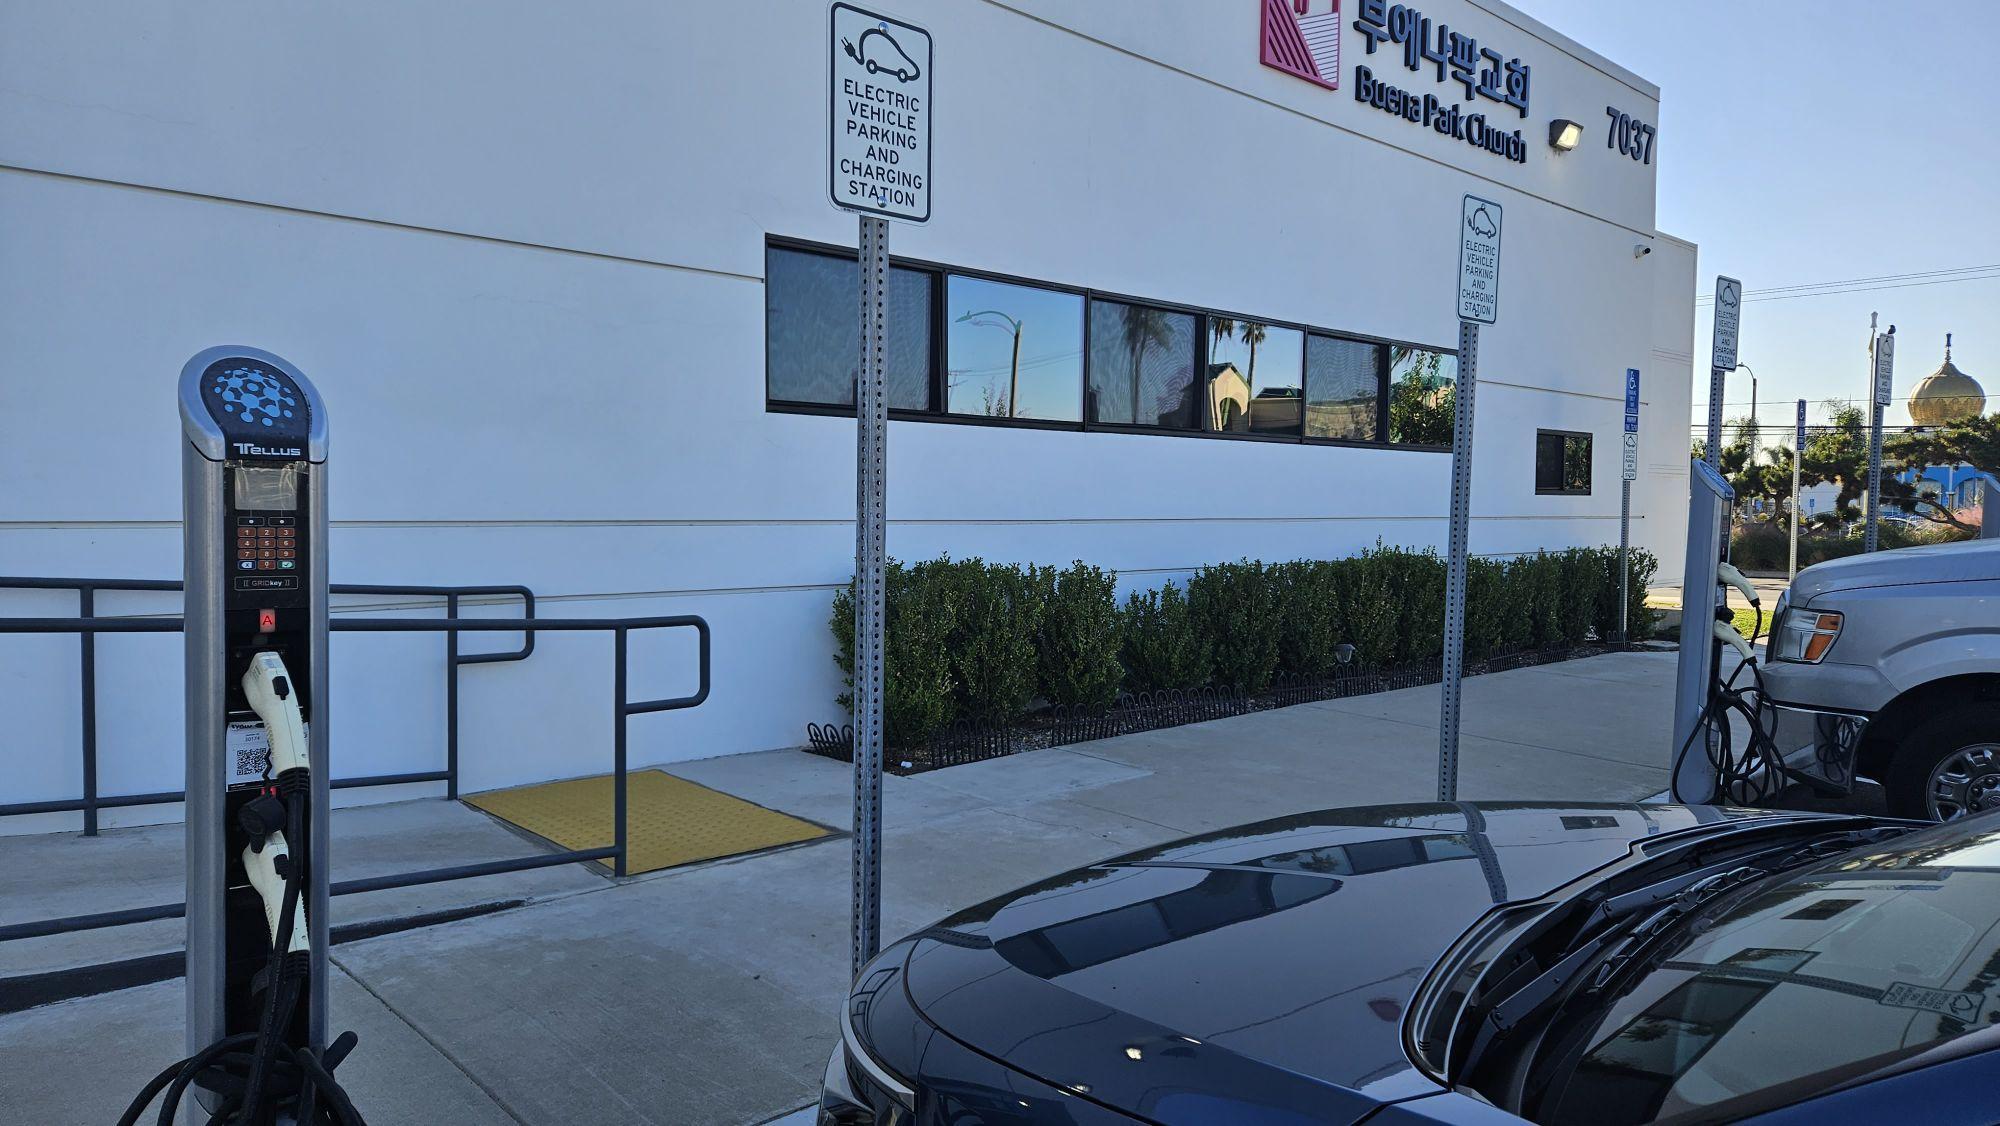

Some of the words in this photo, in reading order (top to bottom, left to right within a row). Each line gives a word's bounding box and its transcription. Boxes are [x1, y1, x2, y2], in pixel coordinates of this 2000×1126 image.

[1353, 0, 1530, 118] 부에나팍교회
[844, 78, 920, 112] ELECTRIC
[848, 99, 917, 132] VEHICLE
[1355, 64, 1422, 123] Buena
[1423, 93, 1466, 141] Park
[1466, 113, 1528, 164] Church
[847, 119, 917, 150] PARKING
[1607, 105, 1656, 165] 7037
[865, 144, 899, 165] AND
[840, 158, 923, 190] CHARGING
[849, 180, 915, 208] STATION
[1466, 240, 1496, 256] ELECTRIC
[1467, 252, 1494, 268] VEHICLE
[1465, 264, 1493, 280] PARKING
[1461, 288, 1494, 304] CHARGING
[1472, 279, 1486, 290] AND
[1464, 301, 1491, 316] STATION
[262, 615, 273, 625] A
